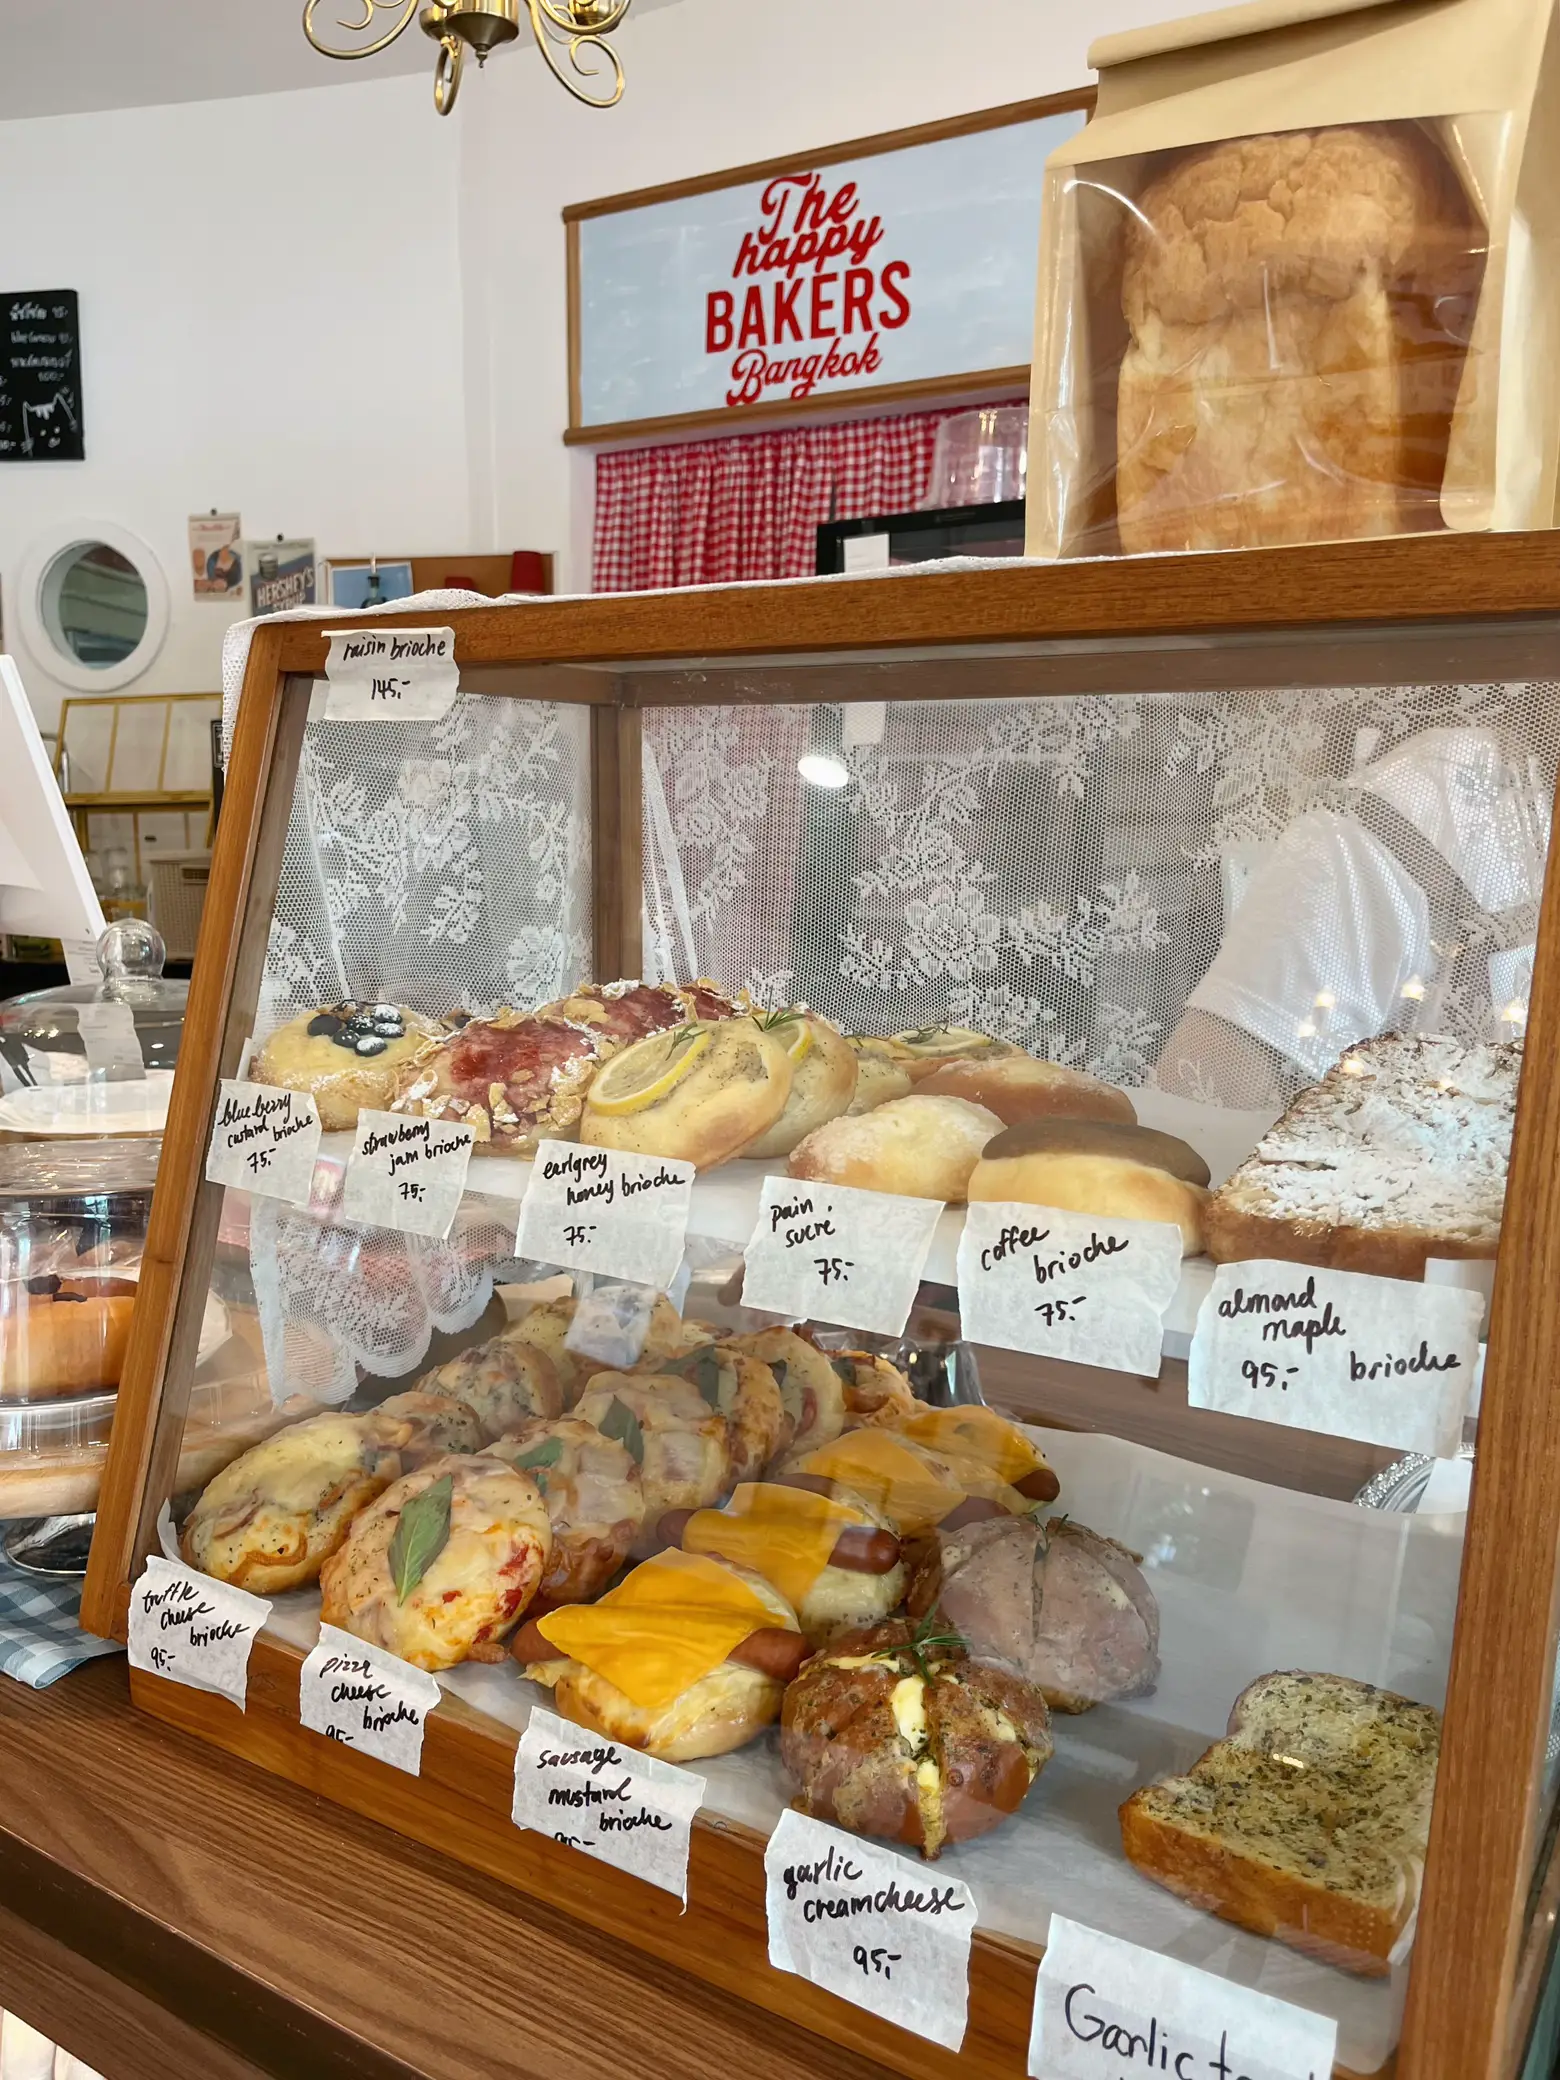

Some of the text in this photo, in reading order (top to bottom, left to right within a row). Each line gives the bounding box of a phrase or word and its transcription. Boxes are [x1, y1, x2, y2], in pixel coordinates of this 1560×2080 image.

[758, 171, 860, 245] The
[732, 216, 884, 279] happy
[706, 261, 911, 353] BAKERS
[726, 332, 883, 406] Bangkok
[257, 566, 314, 609] HERSHEY'S
[343, 634, 446, 661] raisin brioche
[228, 1115, 313, 1148] custard brioche
[388, 1134, 471, 1176] jam brioche
[543, 1152, 607, 1183] earlgrey
[566, 1166, 686, 1205] honey brioche
[770, 1196, 814, 1232] pain
[981, 1225, 1050, 1271] coffee
[1034, 1232, 1129, 1284] brioche
[1218, 1276, 1317, 1318] almond
[1262, 1302, 1347, 1354] maple
[1350, 1340, 1462, 1382] brioche
[142, 1581, 200, 1613] truffle
[160, 1602, 215, 1630] cheese
[190, 1620, 250, 1647] brioche
[319, 1653, 373, 1679] pizza
[331, 1683, 391, 1702] cheese
[362, 1700, 419, 1732] brioche
[536, 1746, 622, 1775] sausage
[548, 1777, 632, 1807] mustard
[599, 1807, 672, 1832] brioche
[783, 1846, 863, 1900] garlic
[804, 1881, 965, 1923] creamcheese
[1065, 1983, 1194, 2080] Garlic
